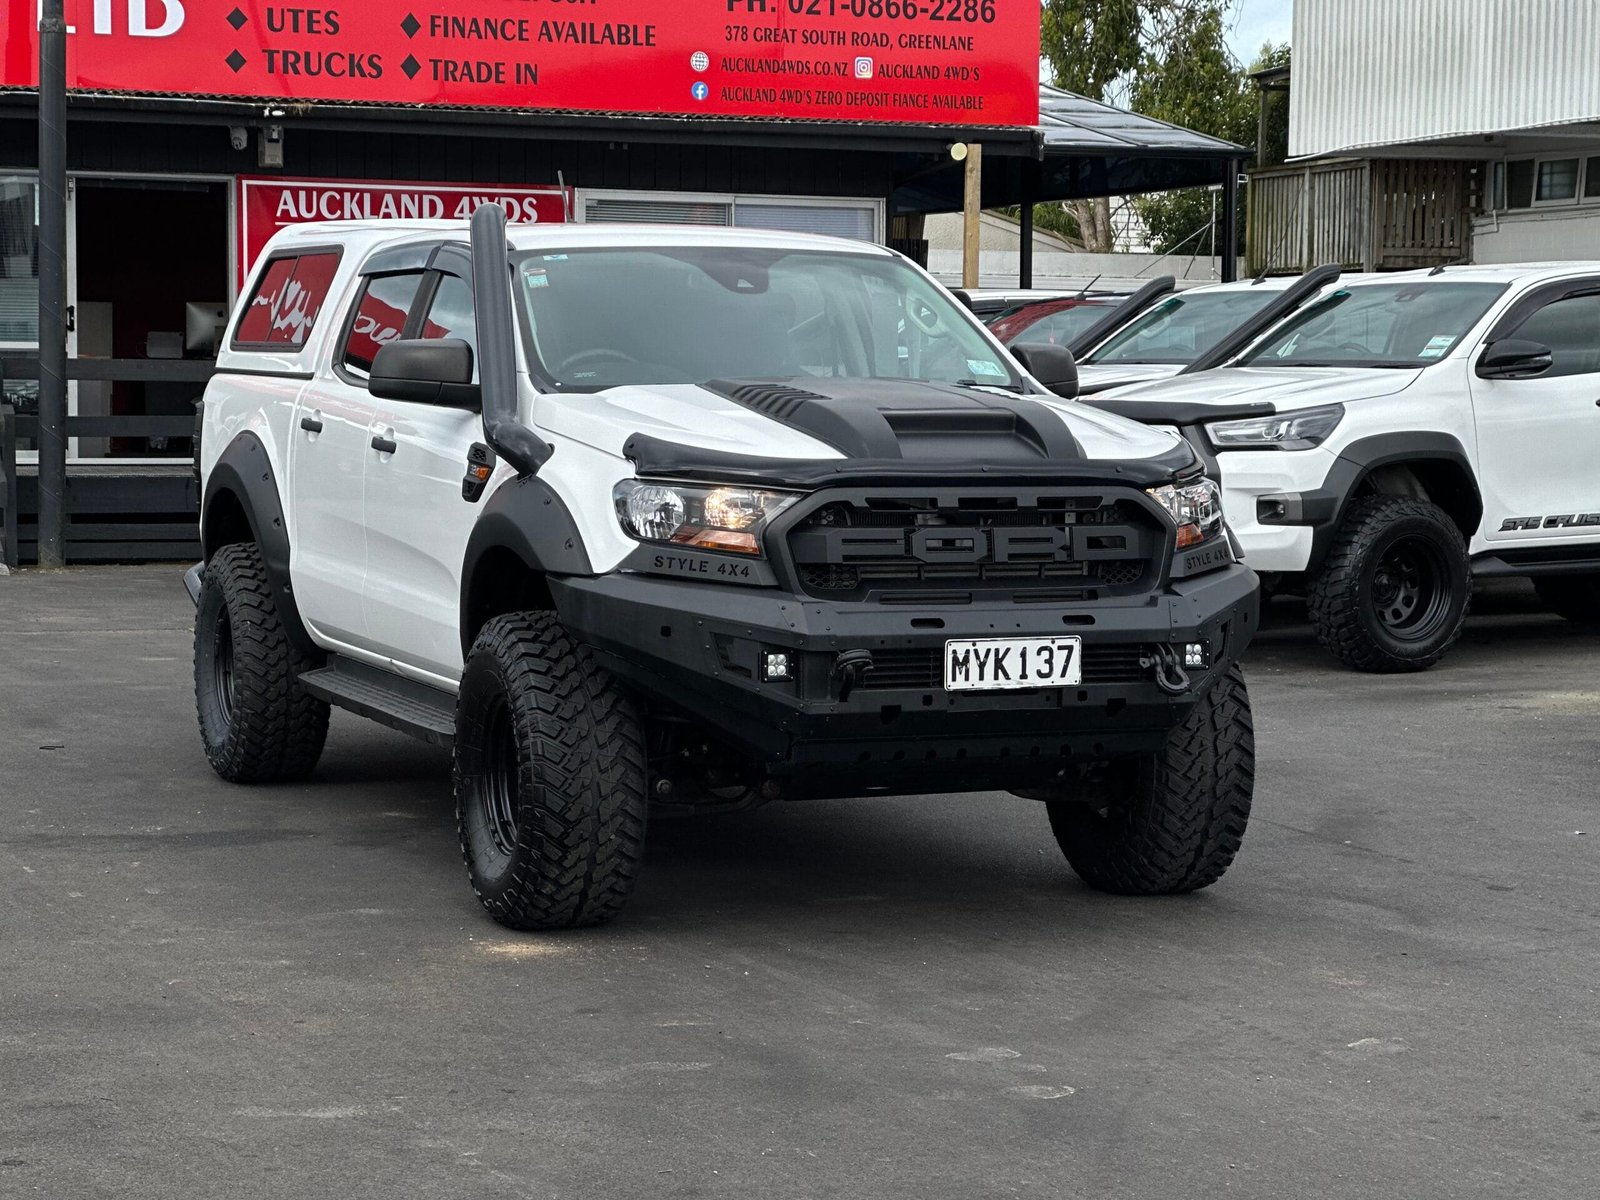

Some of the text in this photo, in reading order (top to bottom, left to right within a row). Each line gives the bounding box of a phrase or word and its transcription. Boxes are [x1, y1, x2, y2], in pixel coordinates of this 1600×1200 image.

[266, 8, 340, 35] UTES
[430, 15, 657, 47] FINANCE AVAILABLE
[725, 25, 975, 51] 378 GREAT SOUTH ROAD, GREENLANE
[262, 49, 384, 79] TRUCKS
[429, 58, 539, 85] TRADE IN
[720, 57, 849, 77] AUCKLAND4WDS.CO.NZ
[878, 63, 941, 80] AUCKLAND
[720, 86, 777, 103] AUCKLAND
[815, 90, 843, 106] ZERO
[846, 91, 890, 107] DEPOSIT
[892, 93, 929, 109] FIANCE
[931, 95, 984, 110] AVAILABLE
[276, 189, 444, 220] AUCKLAND
[1543, 513, 1600, 529] CRUIS
[654, 555, 750, 578] STYLE 4X4
[1186, 552, 1212, 570] STYLE
[951, 644, 1075, 682] MYK137
